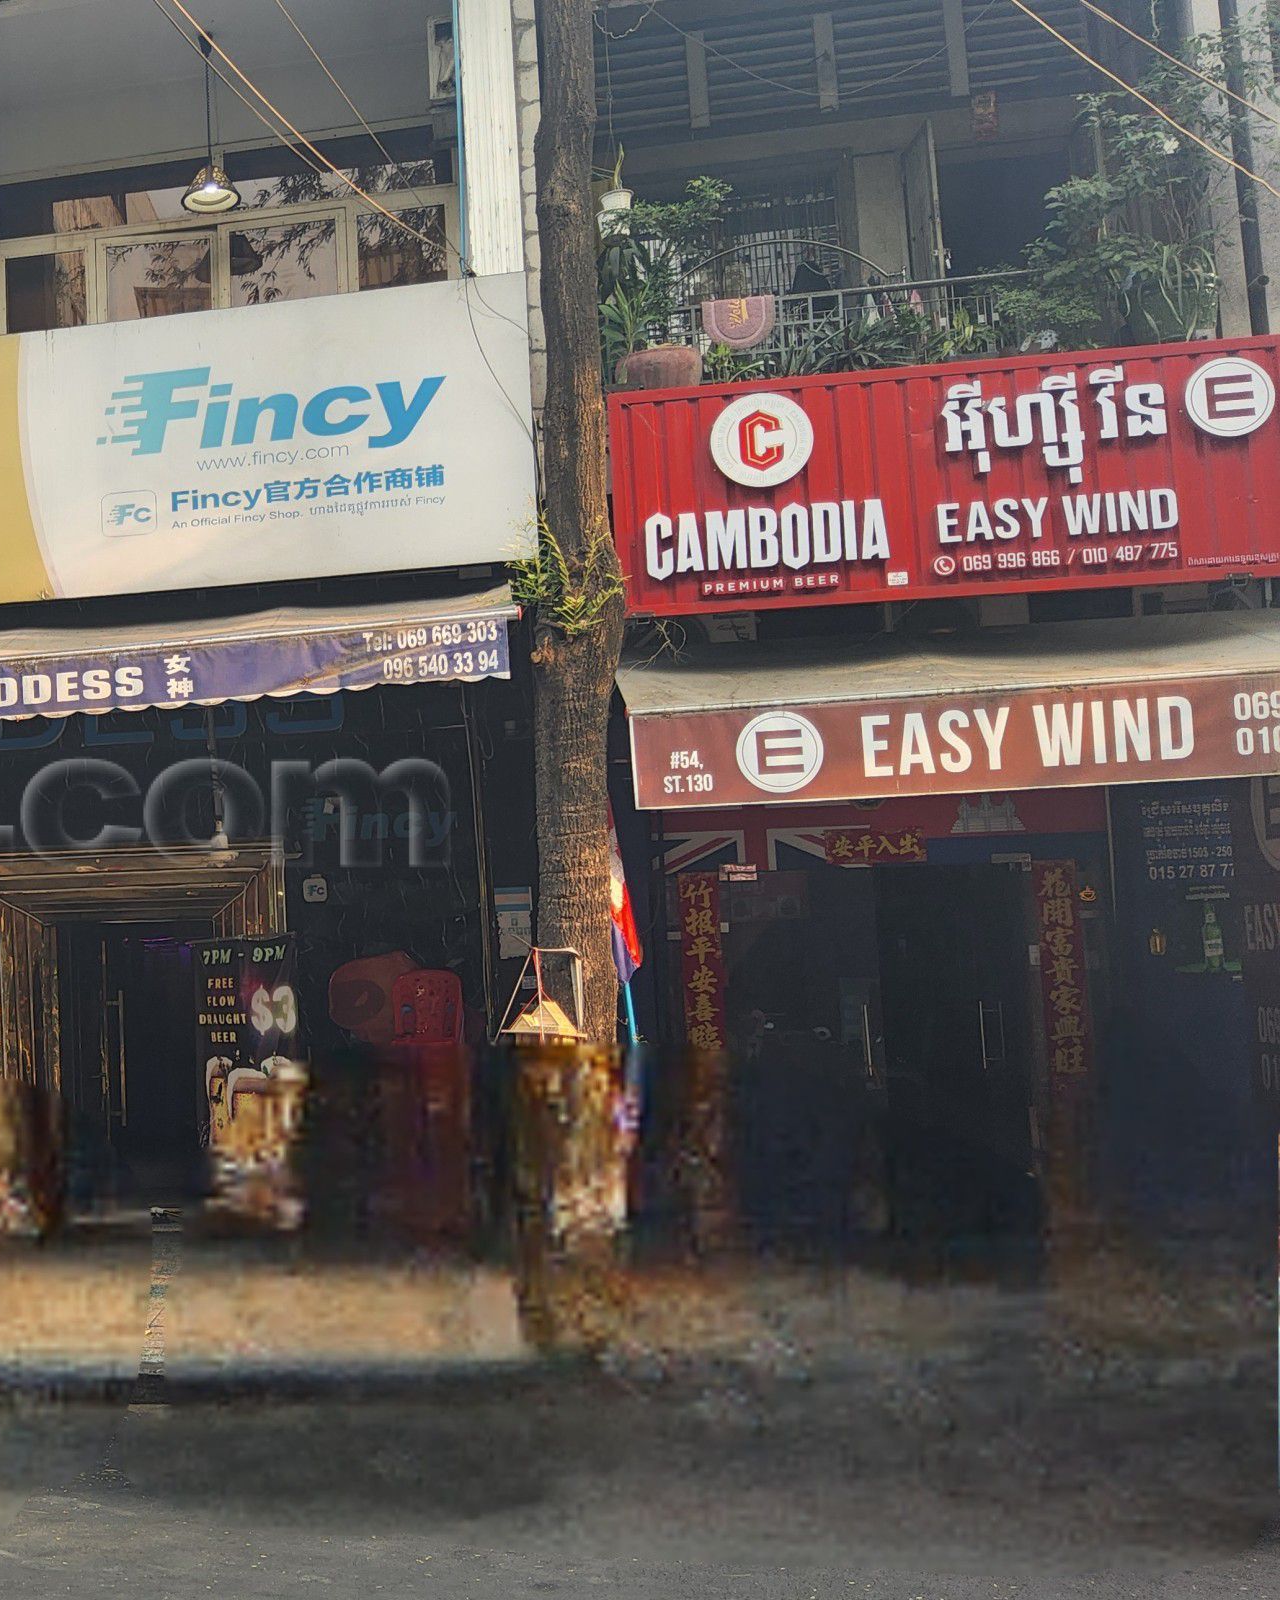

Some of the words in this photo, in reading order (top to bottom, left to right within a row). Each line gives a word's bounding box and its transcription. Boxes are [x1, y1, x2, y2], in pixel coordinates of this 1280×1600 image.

[112, 366, 447, 456] Fincy
[197, 444, 350, 471] www.fincy.com
[415, 494, 446, 507] Fincy
[172, 519, 187, 530] An
[191, 515, 232, 528] Official
[234, 512, 266, 525] Fincy
[270, 511, 304, 523] Shop.
[936, 496, 1049, 544] EASY
[1062, 488, 1180, 537] WIND
[645, 498, 891, 581] CAMBODIA
[963, 555, 992, 572] 069
[997, 552, 1026, 569] 996
[1031, 549, 1060, 567] 866
[1082, 547, 1107, 564] 010
[1115, 544, 1141, 561] 487
[1151, 541, 1178, 559] 775
[704, 577, 785, 595] PREMIUM
[794, 573, 841, 588] BEER
[362, 632, 393, 653] Tel:
[397, 628, 427, 650] 069
[432, 623, 462, 646] 669
[467, 619, 498, 643] 303
[163, 654, 194, 699] 女神
[383, 656, 414, 680] 096
[418, 653, 449, 677] 540
[453, 652, 474, 674] 33
[478, 649, 499, 671] 94
[860, 707, 1010, 778] EASY
[1032, 696, 1195, 767] WIND
[669, 749, 705, 771] #54,
[1149, 865, 1176, 881] 015
[1180, 864, 1195, 879] 27
[1200, 863, 1216, 878] 87
[203, 948, 232, 965] 7PM
[252, 944, 286, 963] 9PM
[207, 977, 234, 989] FREE
[207, 995, 236, 1007] FLOW
[251, 984, 297, 1036] $3
[199, 1013, 247, 1025] DRAUGHT
[211, 1031, 237, 1043] BEER
